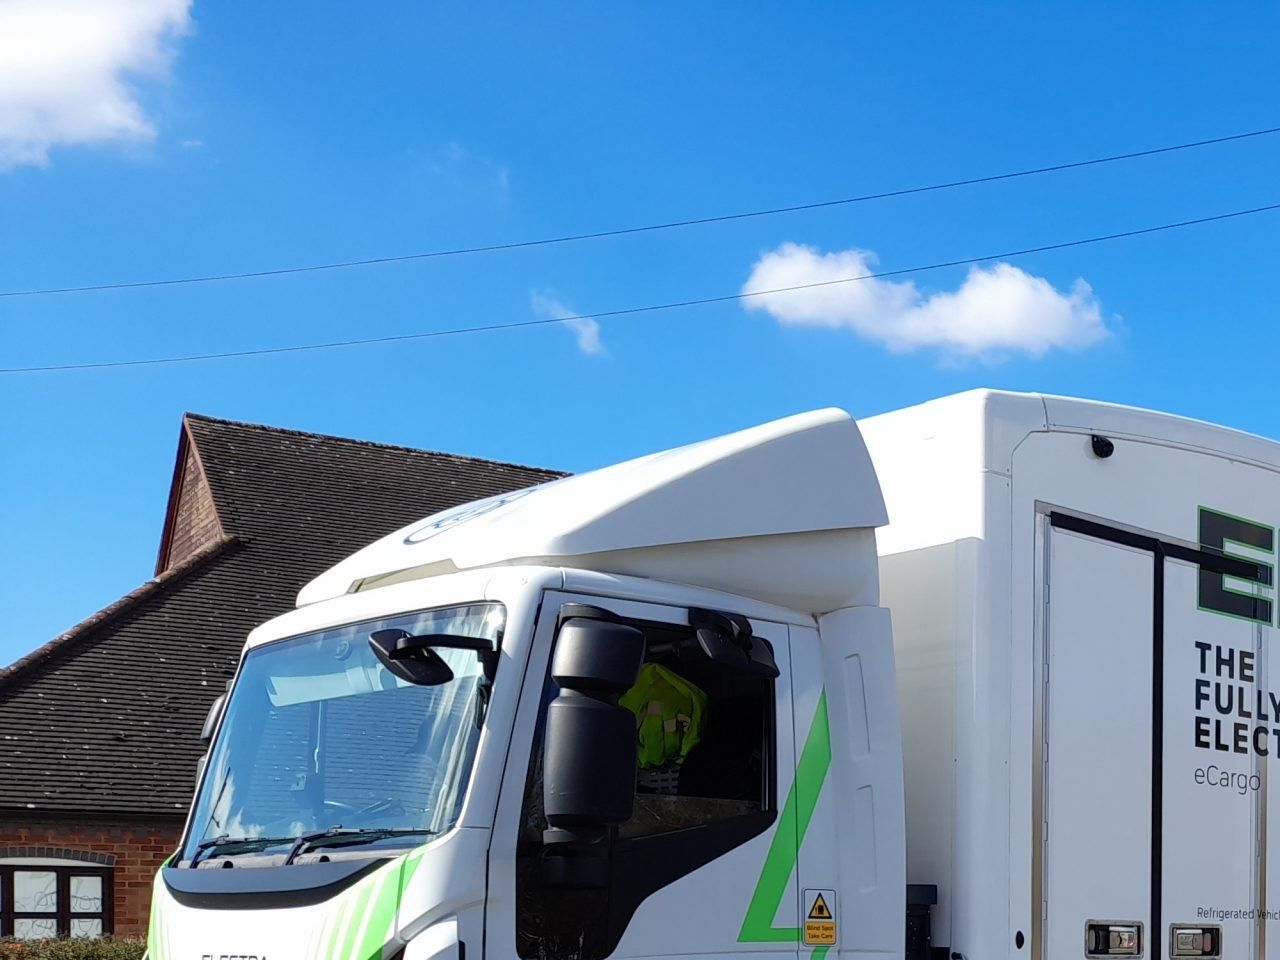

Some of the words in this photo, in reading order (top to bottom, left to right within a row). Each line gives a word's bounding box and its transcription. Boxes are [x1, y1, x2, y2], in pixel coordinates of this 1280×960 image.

[1195, 641, 1254, 683] THE
[1194, 765, 1261, 795] eCargo
[1197, 907, 1255, 921] Refrigerated
[821, 924, 834, 932] Spot
